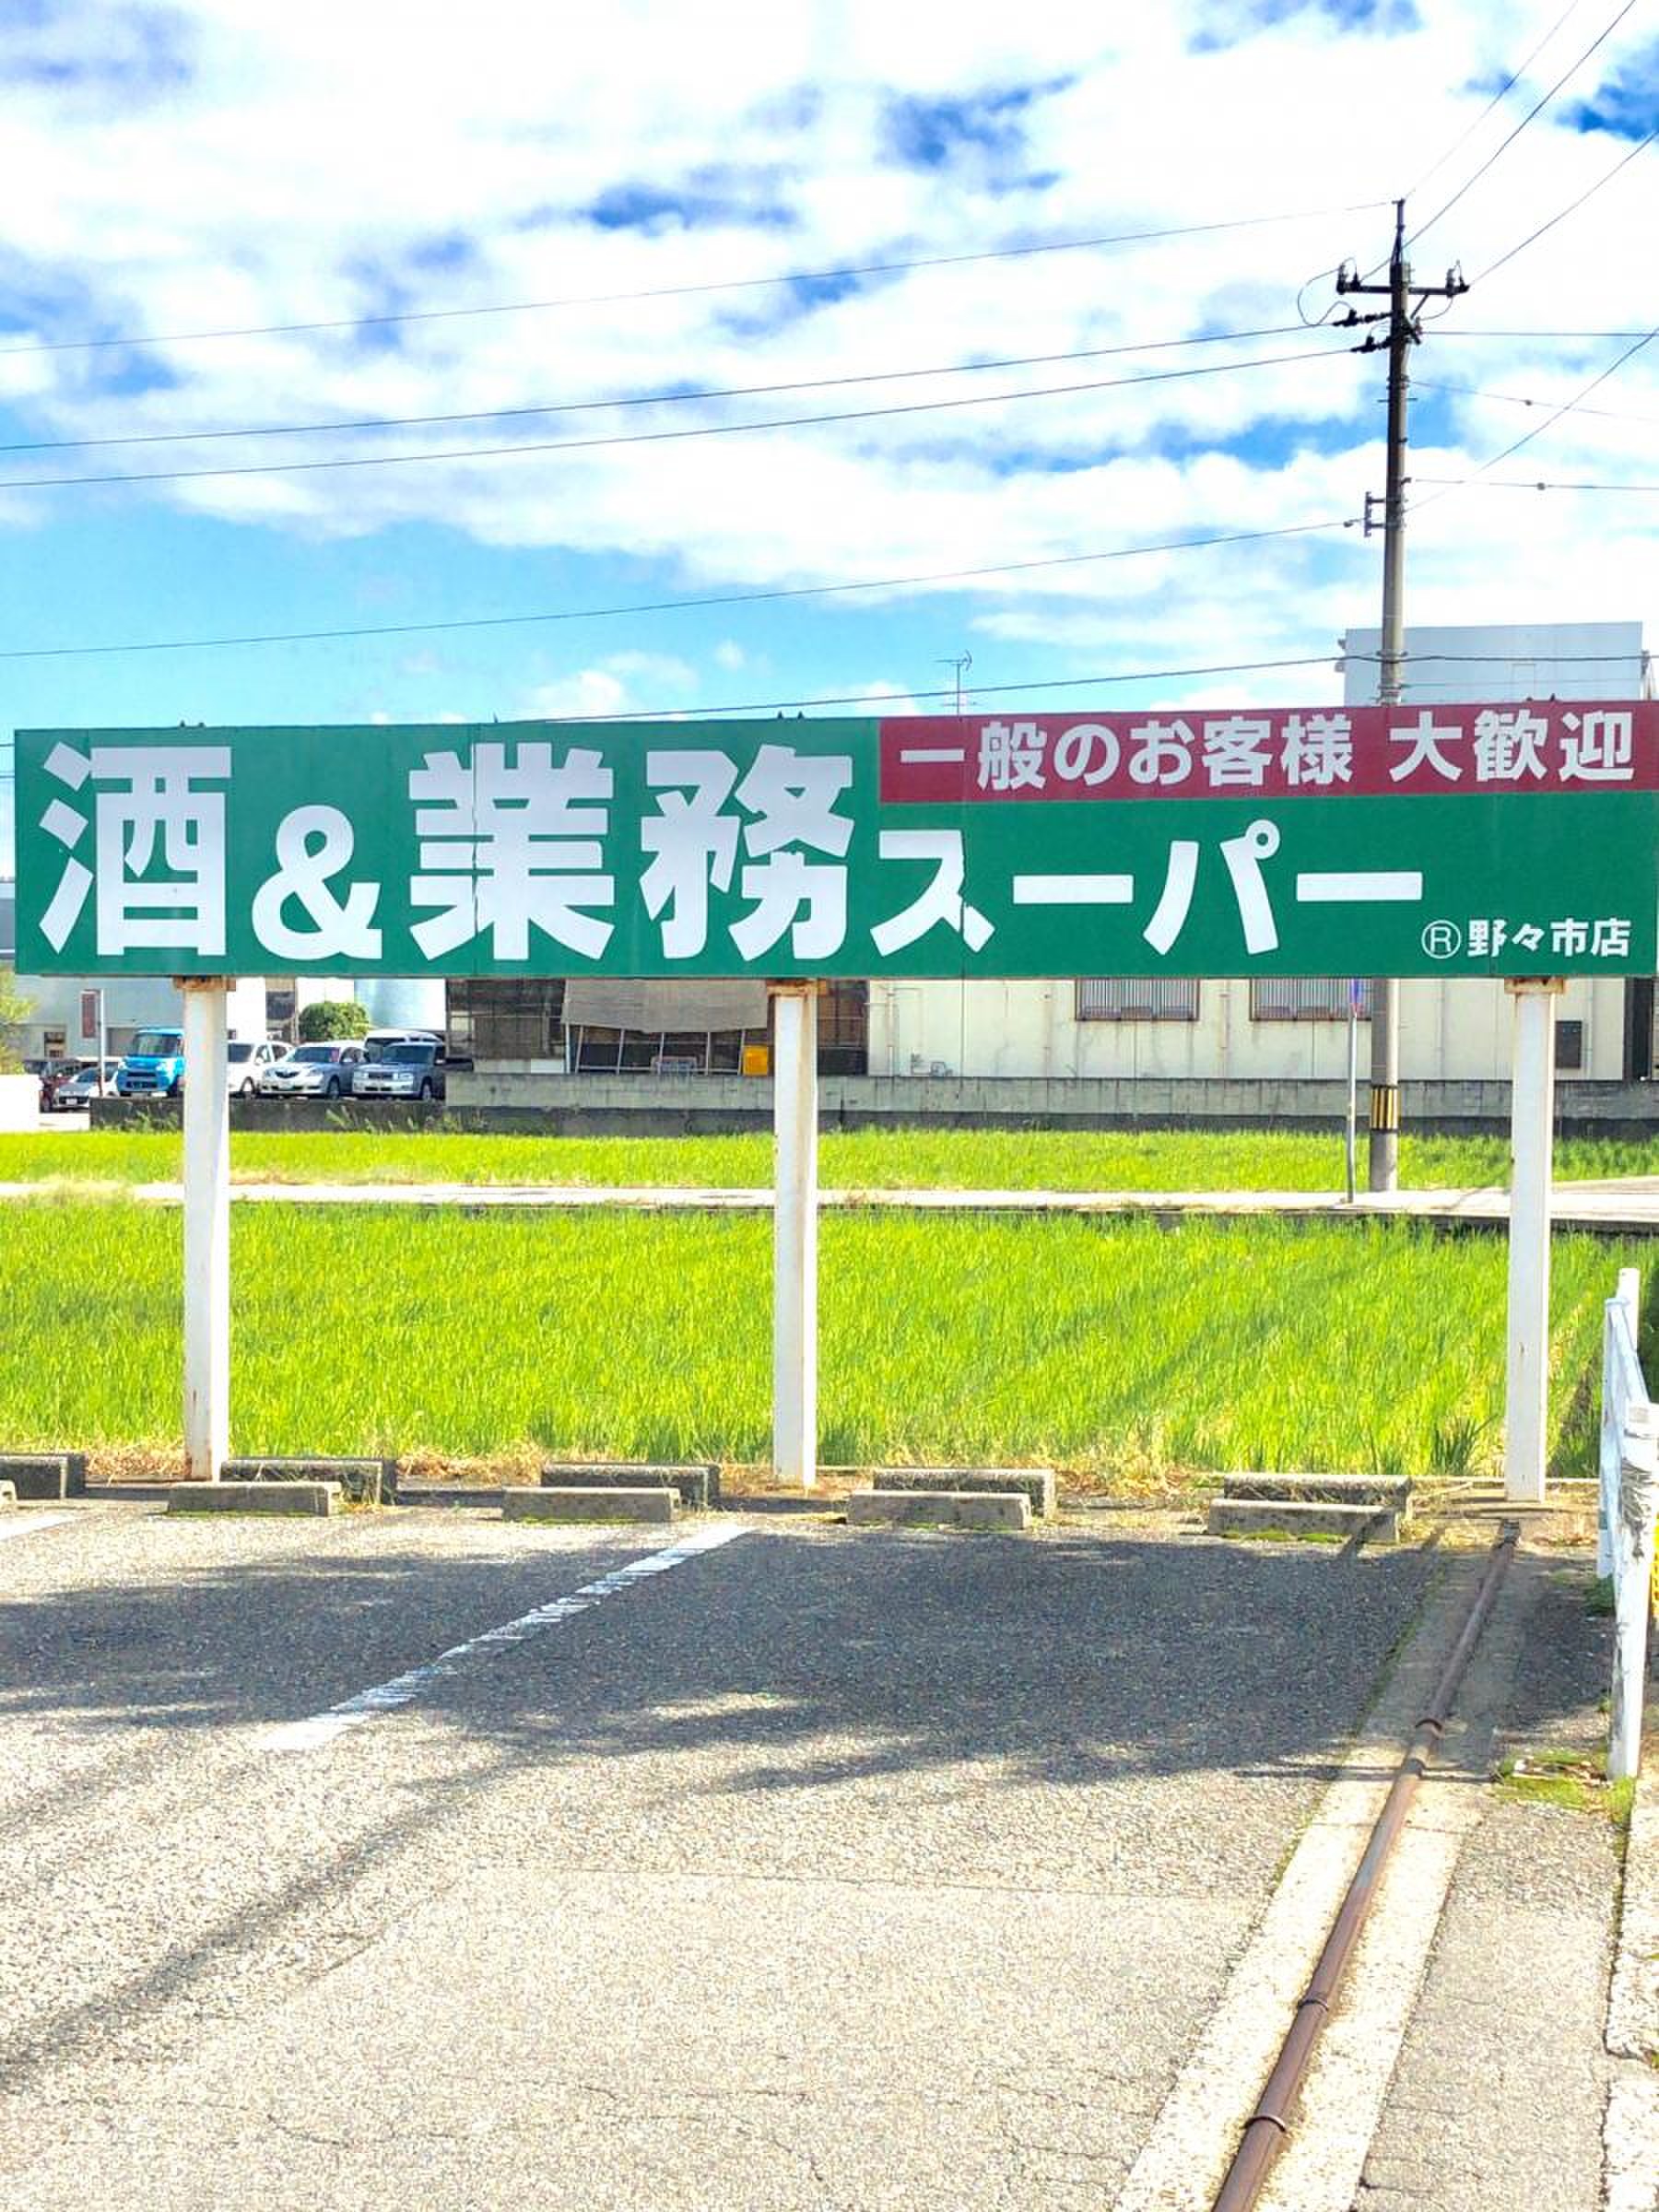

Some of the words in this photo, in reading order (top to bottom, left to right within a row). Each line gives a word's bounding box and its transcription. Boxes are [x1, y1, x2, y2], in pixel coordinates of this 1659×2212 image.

[900, 718, 1353, 791] 一般のお客様
[1389, 710, 1635, 783] 大歓迎
[1467, 917, 1631, 958] 野々市店
